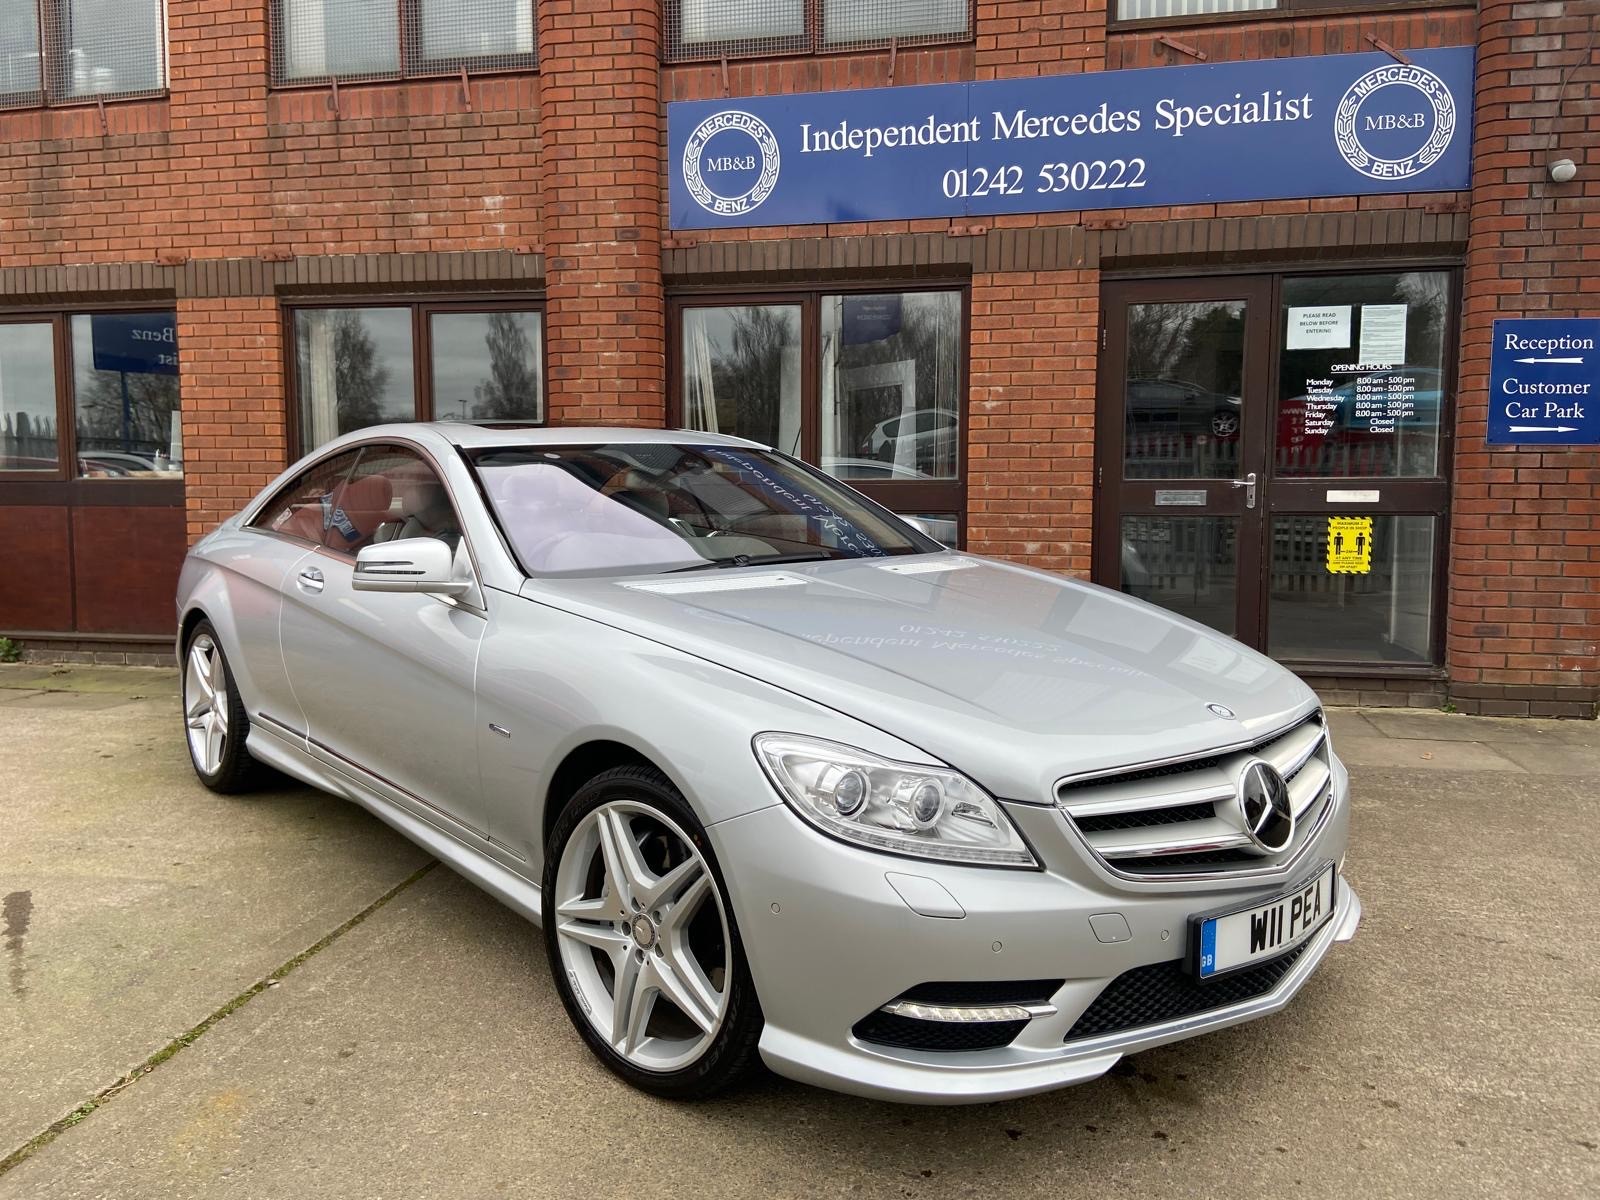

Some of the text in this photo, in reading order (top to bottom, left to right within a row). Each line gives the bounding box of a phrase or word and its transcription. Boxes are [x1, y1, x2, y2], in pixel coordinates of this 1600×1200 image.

[1354, 68, 1439, 97] MERCEDES
[697, 114, 766, 140] MERCEDES
[800, 90, 1313, 157] Independent Mercedes Specialist
[1364, 113, 1425, 130] MB&B
[707, 156, 756, 172] MB&B
[1371, 160, 1416, 176] BENZ
[943, 158, 1147, 198] 01242 530222
[714, 198, 750, 212] BENZ
[1504, 334, 1594, 355] Reception
[1502, 378, 1590, 394] Customer
[1306, 403, 1337, 412] Thursday
[1506, 402, 1584, 418] Car Park
[1305, 420, 1334, 428] Saturday
[1305, 428, 1328, 436] Sunday
[1290, 880, 1320, 938] PEA
[1202, 954, 1212, 967] GB
